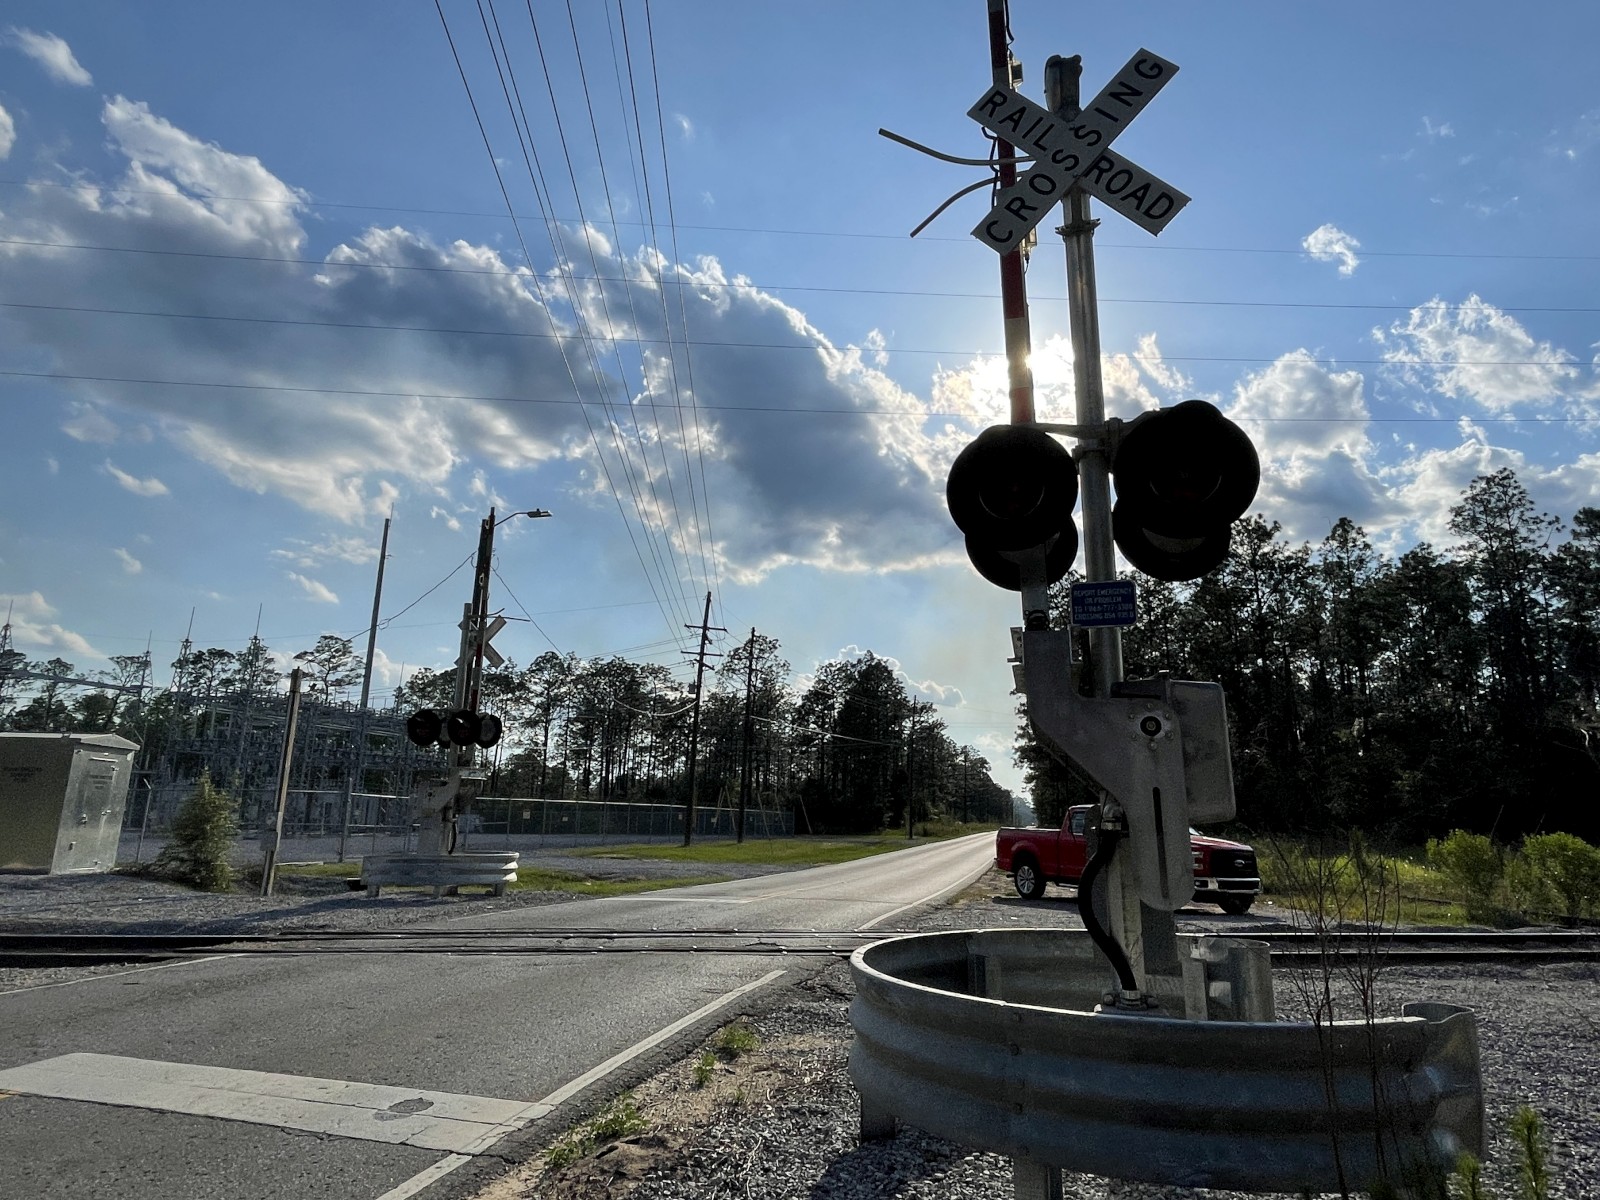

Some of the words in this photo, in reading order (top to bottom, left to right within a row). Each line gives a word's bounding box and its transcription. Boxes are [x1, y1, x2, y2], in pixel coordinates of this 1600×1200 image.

[978, 90, 1055, 152] RAIL
[1083, 155, 1174, 220] ROAD
[985, 58, 1164, 243] CROSSING
